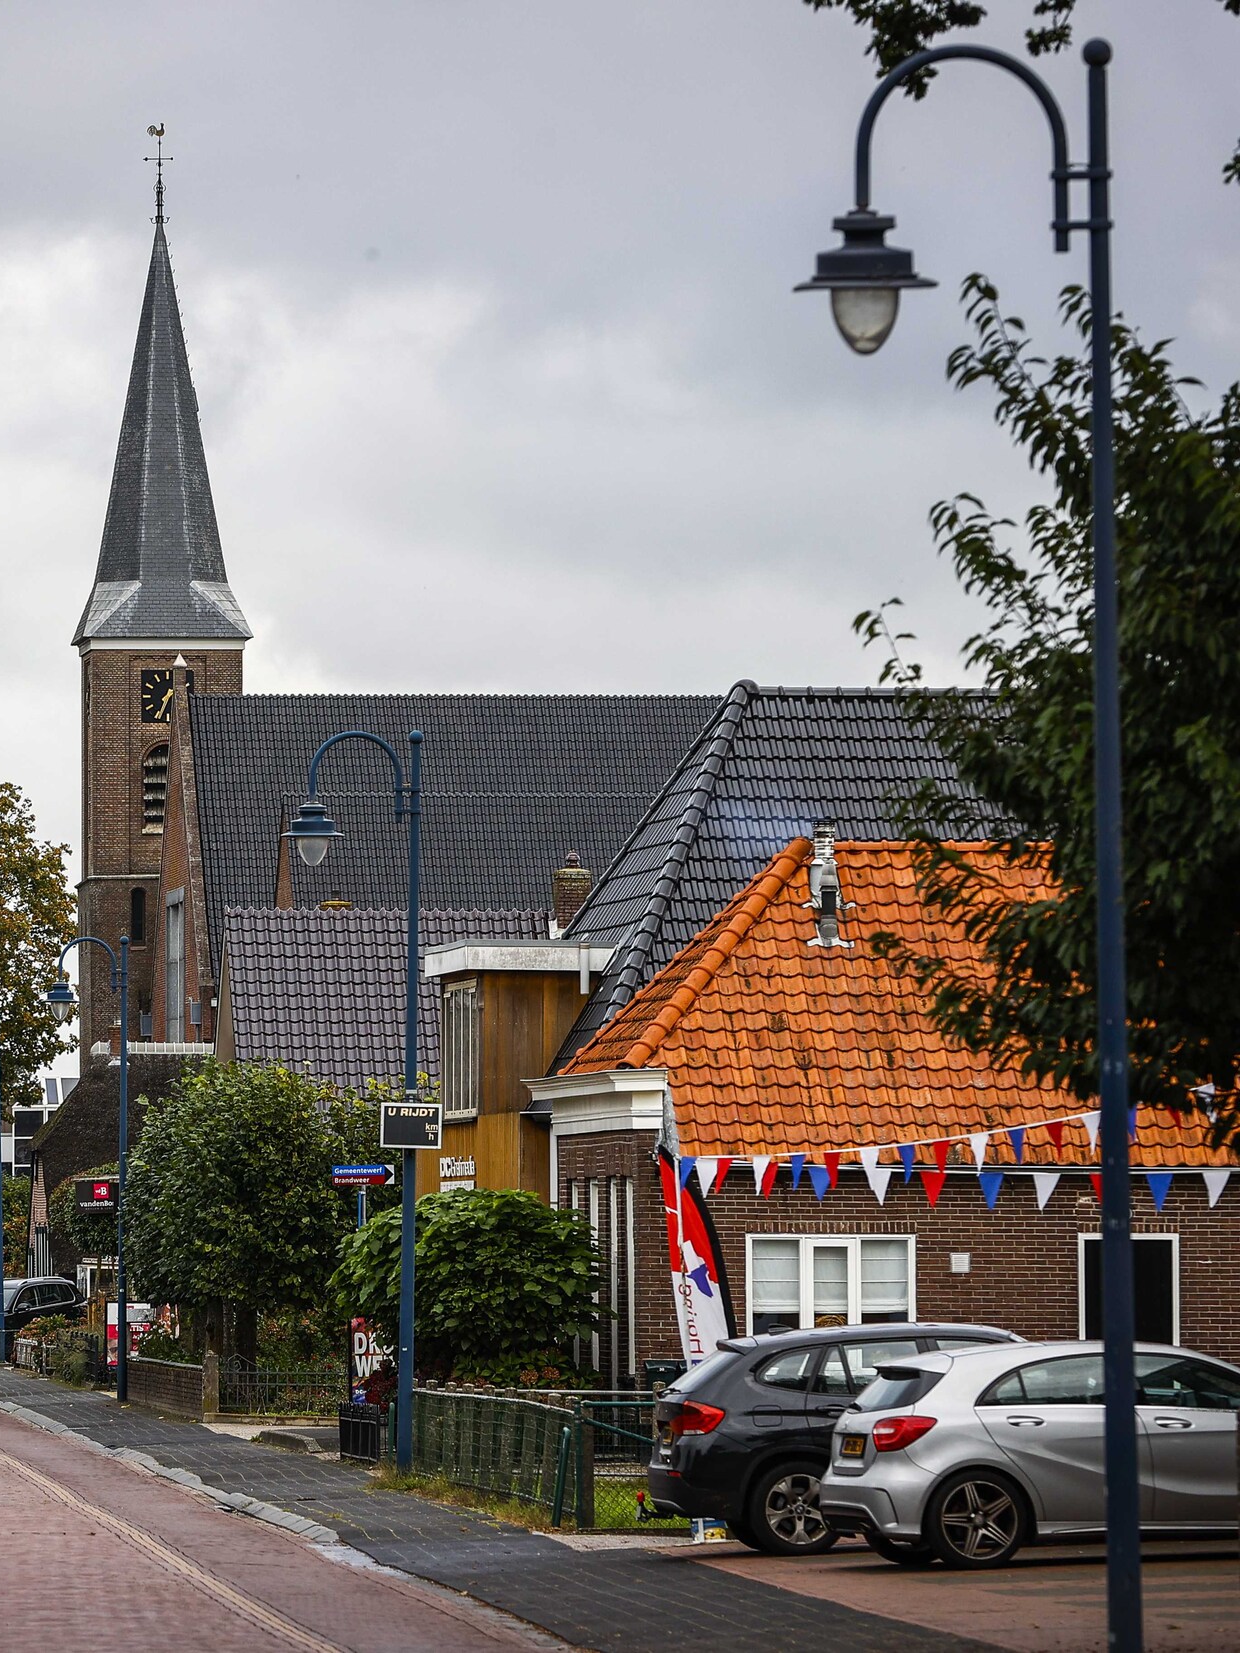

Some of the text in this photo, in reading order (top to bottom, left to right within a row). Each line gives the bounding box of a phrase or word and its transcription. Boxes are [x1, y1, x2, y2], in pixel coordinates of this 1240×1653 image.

[388, 1108, 435, 1117] U RIJDT
[425, 1122, 438, 1130] km
[428, 1132, 434, 1140] h
[334, 1167, 382, 1175] Gemeentewerf
